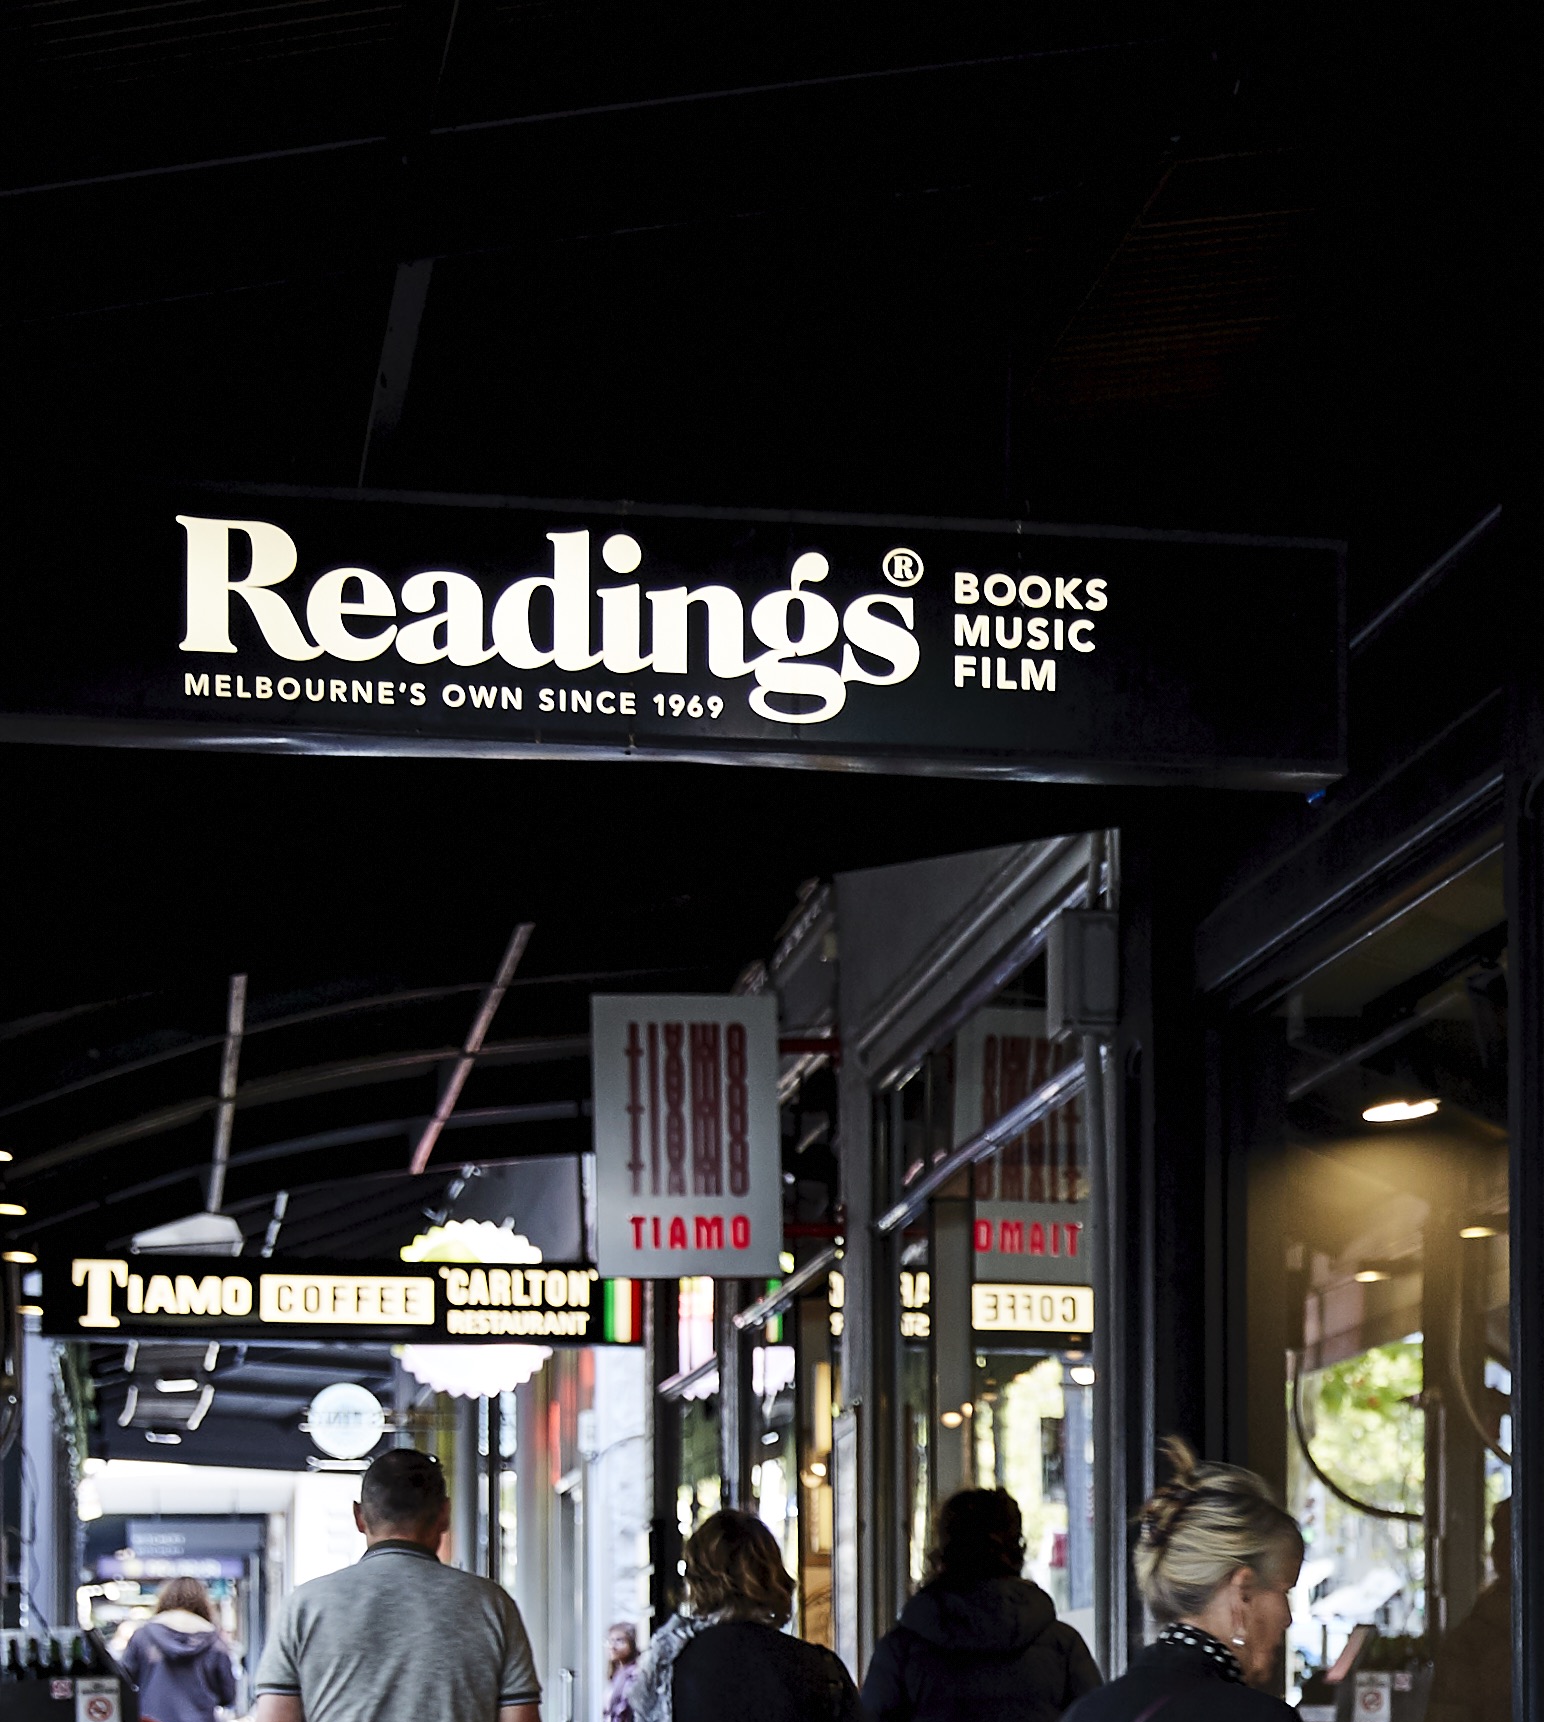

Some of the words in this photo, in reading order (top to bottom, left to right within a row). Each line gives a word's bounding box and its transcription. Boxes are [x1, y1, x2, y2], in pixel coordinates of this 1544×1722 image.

[954, 571, 1108, 612] BOOKS
[175, 514, 920, 724] Readings
[954, 613, 1096, 653] MUSIC
[954, 654, 1056, 692] FILM
[184, 672, 427, 706] MELBOURNE'S
[441, 683, 523, 711] OWN
[538, 687, 637, 715] SINCE
[652, 693, 724, 719] 1969
[629, 1214, 751, 1250] TIAMO
[71, 1258, 253, 1328] TIAMO
[276, 1283, 421, 1316] COFFEE
